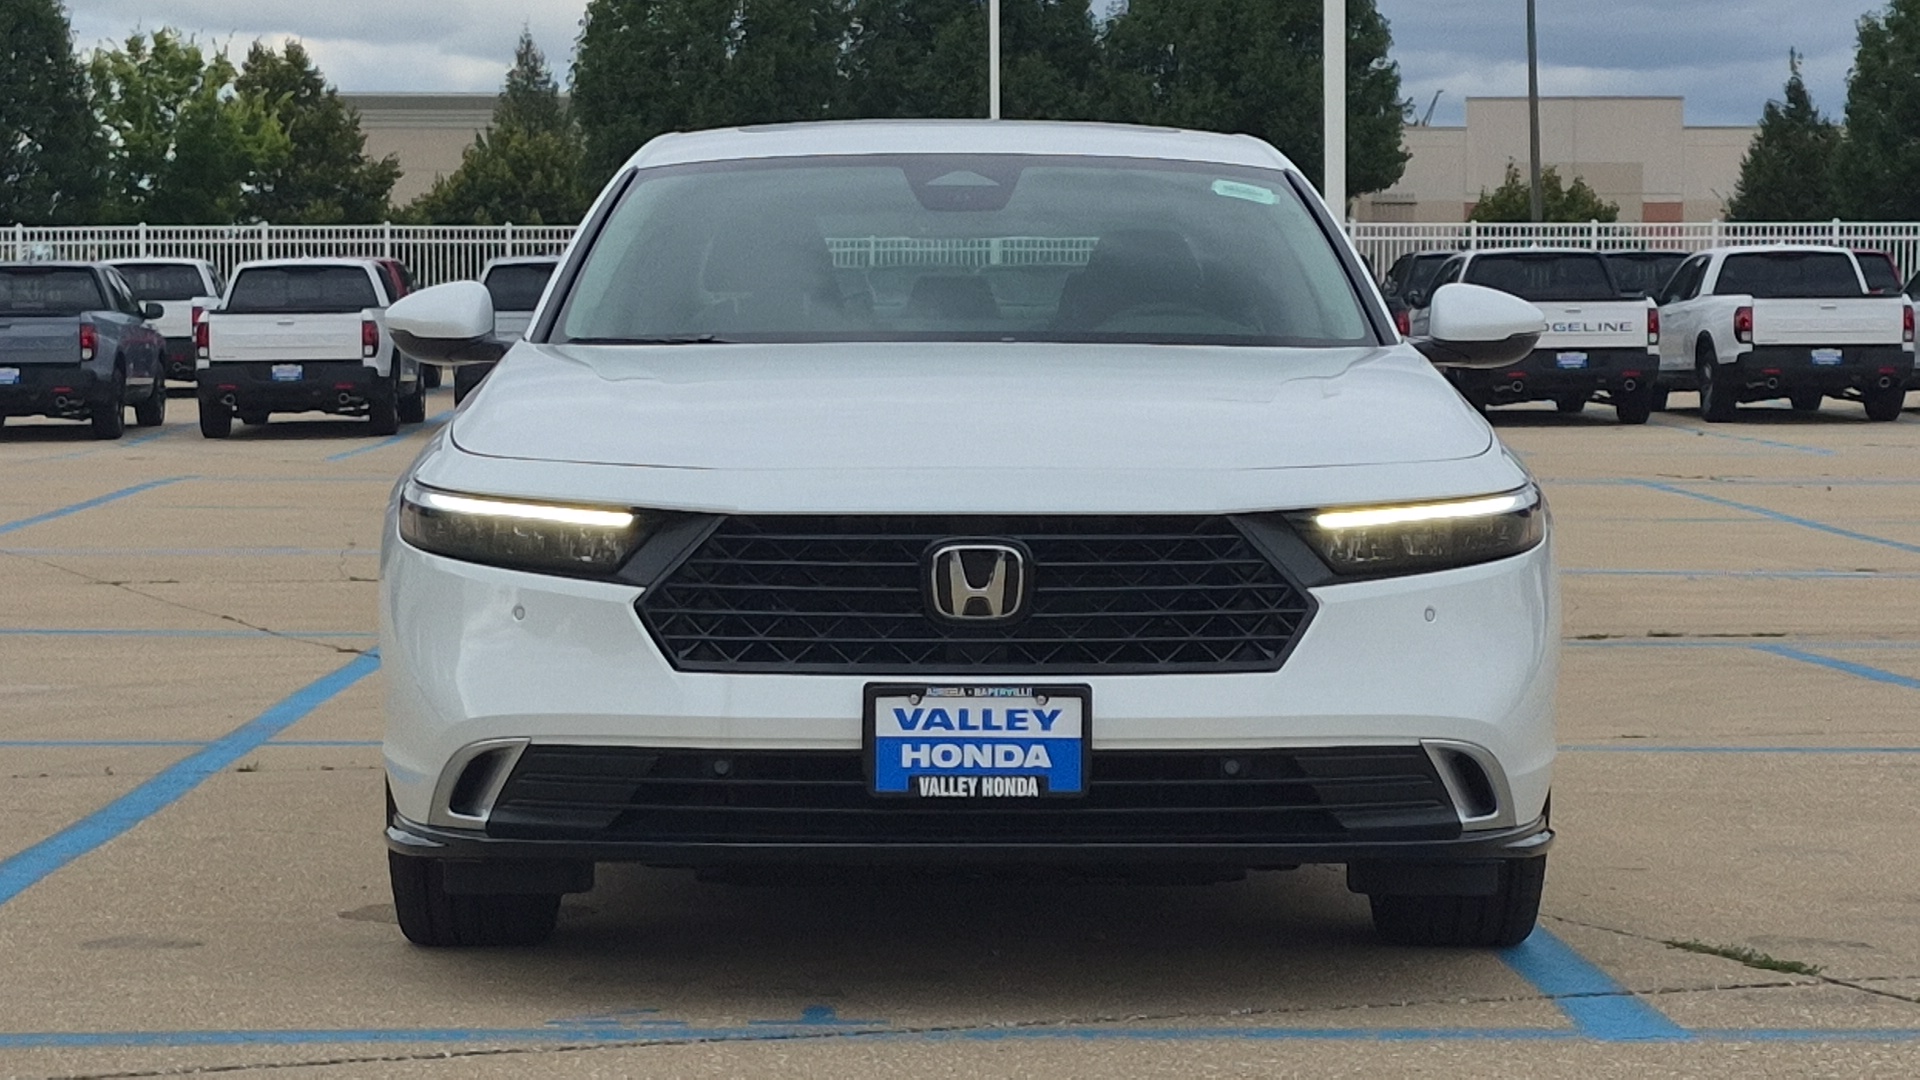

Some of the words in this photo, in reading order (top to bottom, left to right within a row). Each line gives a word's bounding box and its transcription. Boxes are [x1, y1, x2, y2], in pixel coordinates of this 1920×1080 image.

[893, 707, 1062, 731] VALLEY
[901, 743, 1053, 769] HONDA
[918, 776, 978, 798] VALLEY
[981, 776, 1040, 798] HONDA
